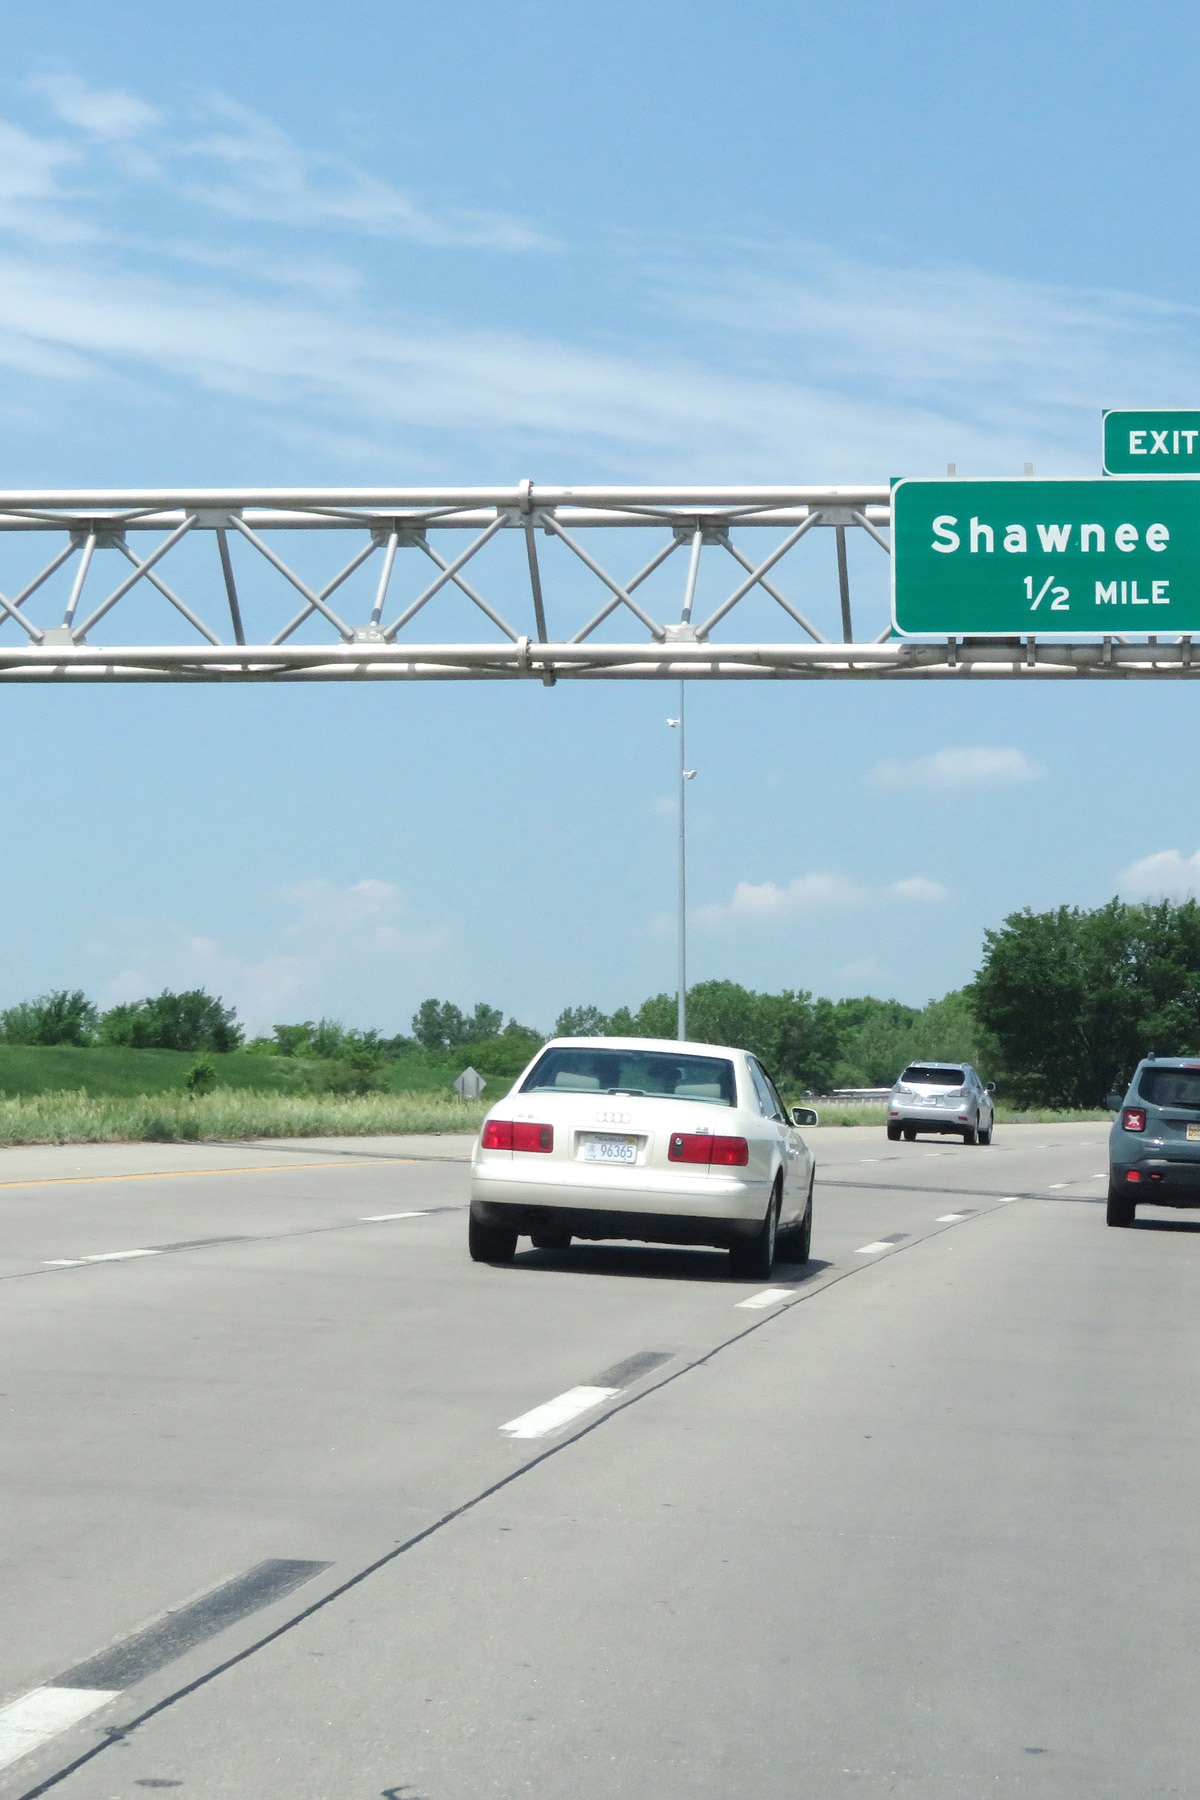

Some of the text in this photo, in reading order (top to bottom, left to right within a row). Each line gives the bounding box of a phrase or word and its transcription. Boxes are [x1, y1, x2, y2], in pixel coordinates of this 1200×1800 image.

[1129, 430, 1199, 455] EXIT
[931, 515, 1170, 554] Shawnee
[1095, 580, 1171, 605] MILE
[600, 1144, 633, 1158] 96365
